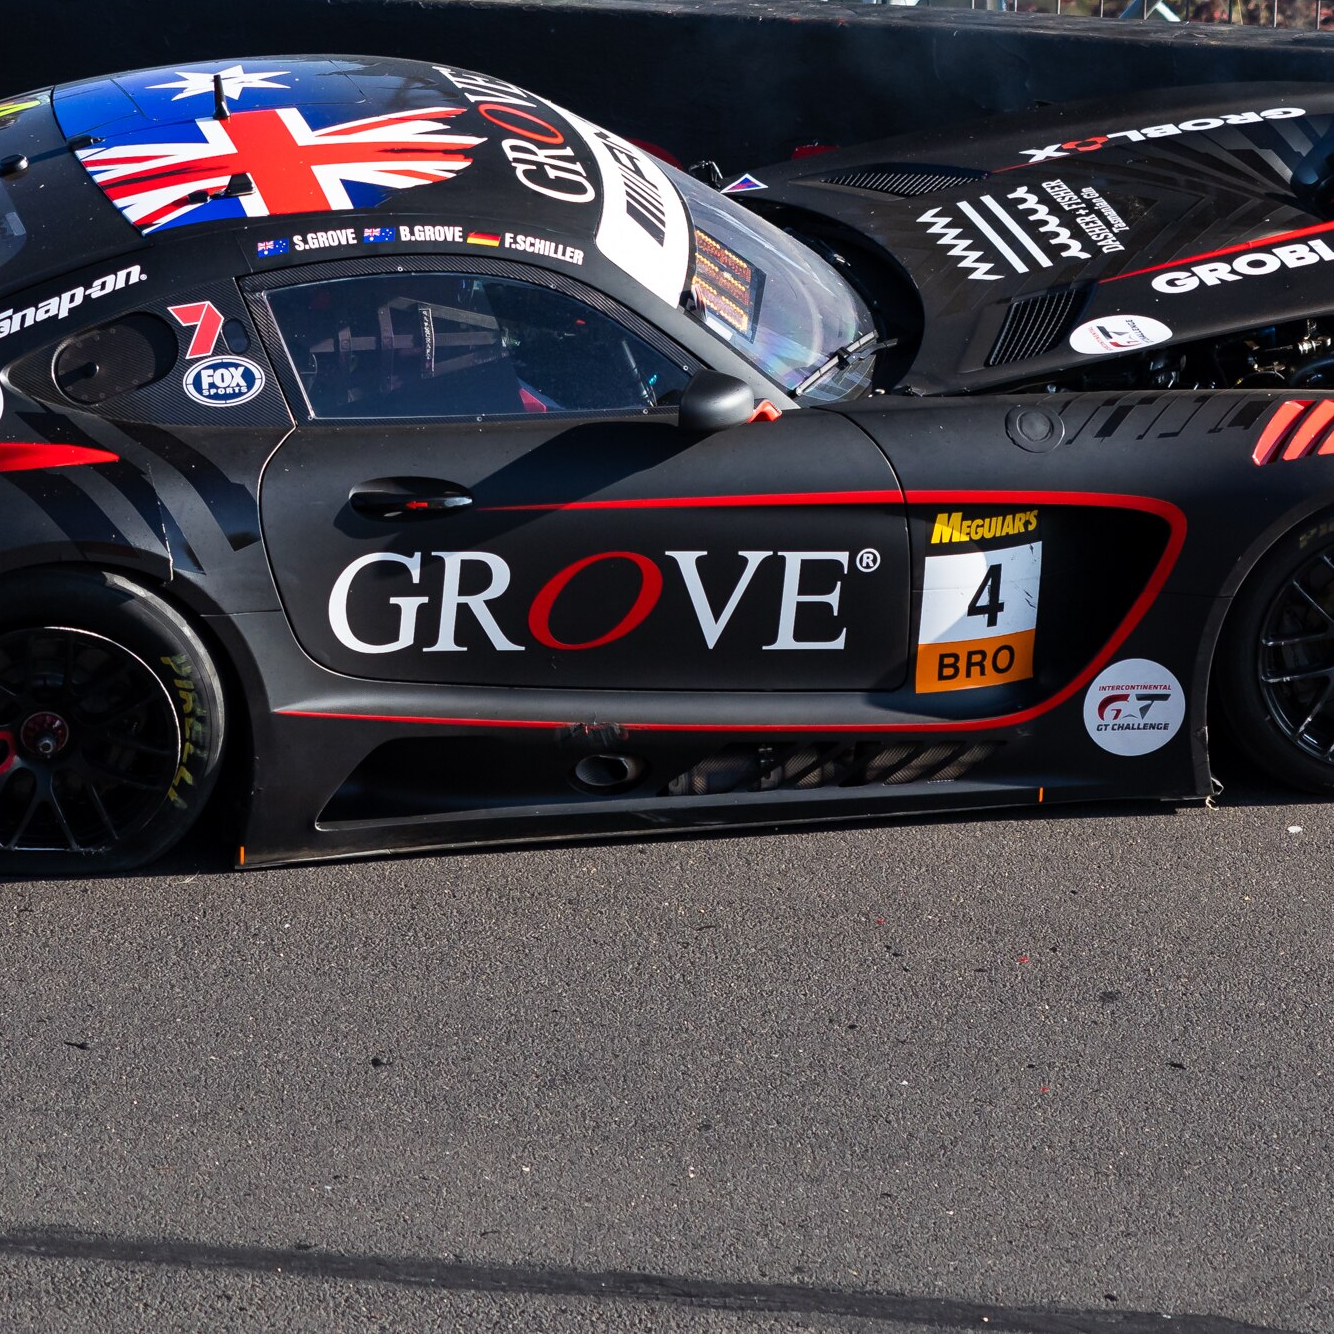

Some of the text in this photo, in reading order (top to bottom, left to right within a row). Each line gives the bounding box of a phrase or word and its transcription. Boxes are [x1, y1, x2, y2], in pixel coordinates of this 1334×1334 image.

[1019, 107, 1306, 163] GROBLOX
[1041, 178, 1086, 212] FISHER
[293, 226, 585, 266] S.GROVE B.GROVE F.SCHILLER
[1076, 213, 1126, 254] DASHER
[200, 368, 247, 389] FOX
[202, 386, 248, 396] SPORTS
[966, 562, 1005, 628] 4
[937, 644, 1016, 682] BRO
[1098, 684, 1172, 692] INTERCONTINENTAL
[1096, 722, 1170, 732] GT CHALLENGE
